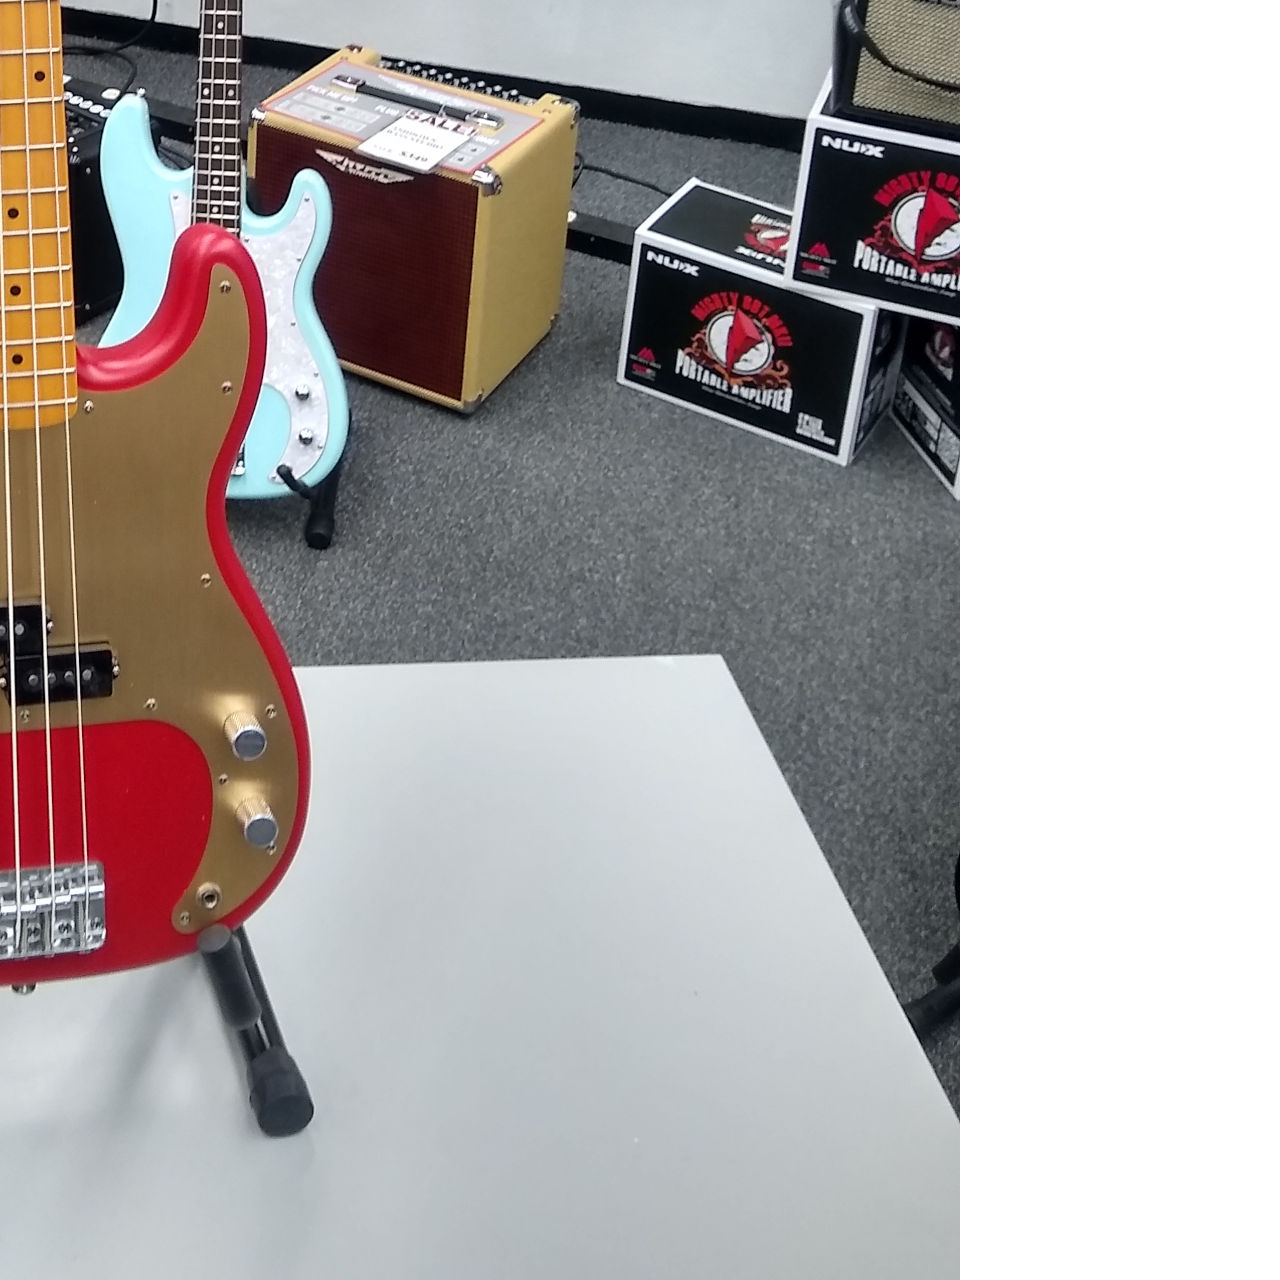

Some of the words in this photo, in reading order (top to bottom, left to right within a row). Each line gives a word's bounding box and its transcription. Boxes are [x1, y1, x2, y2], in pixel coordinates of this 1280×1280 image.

[821, 135, 885, 158] NUX
[646, 251, 702, 277] NUX
[853, 239, 917, 282] PORTABLE
[675, 348, 729, 393] PORTABLE
[731, 384, 793, 414] AMPLIFIER
